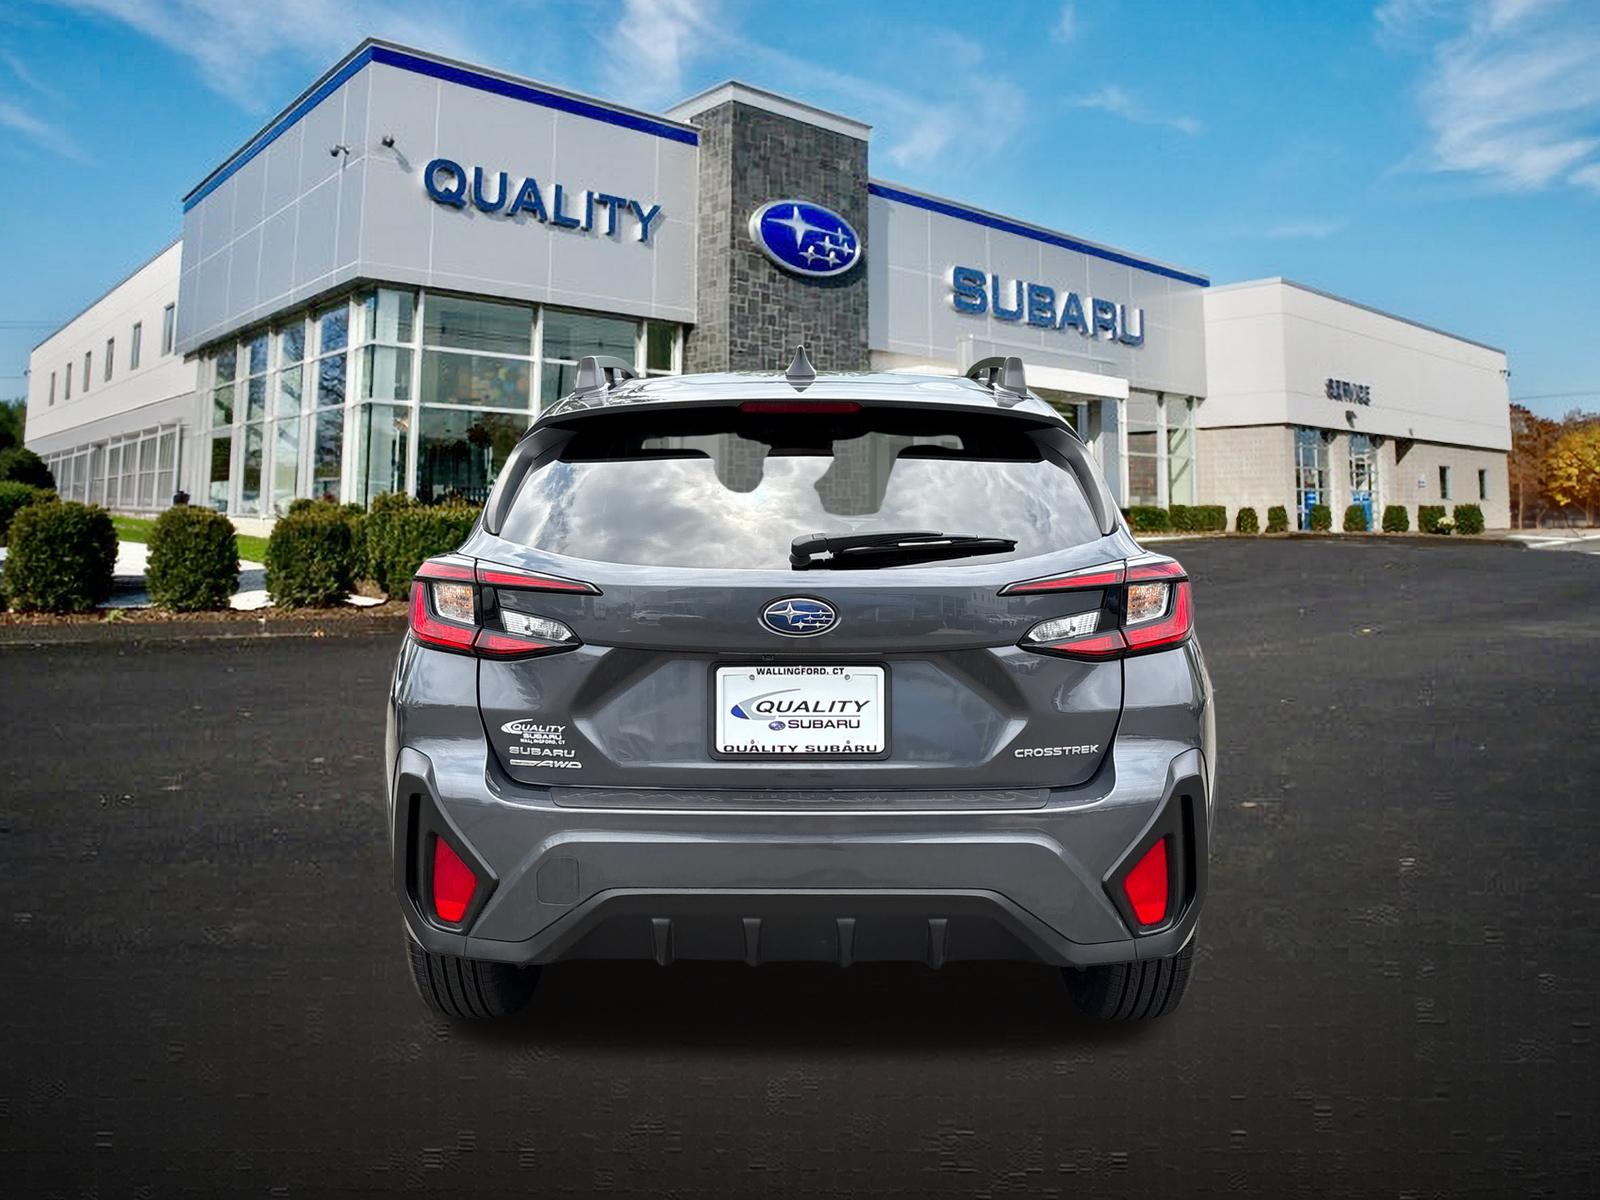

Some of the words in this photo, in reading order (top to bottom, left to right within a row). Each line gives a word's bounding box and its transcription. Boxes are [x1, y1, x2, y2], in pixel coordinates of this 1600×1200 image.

[424, 158, 661, 242] QUALITY
[950, 265, 1145, 346] SUBARU
[832, 667, 845, 676] CT
[755, 700, 871, 714] QUALITY
[512, 724, 566, 733] QUALITY
[787, 719, 861, 730] SUBARU
[509, 746, 576, 758] SUBARU
[723, 744, 799, 753] QUALITY
[804, 744, 878, 753] SUBARU
[1014, 744, 1099, 758] CROSSTREK
[536, 760, 583, 769] AWD
